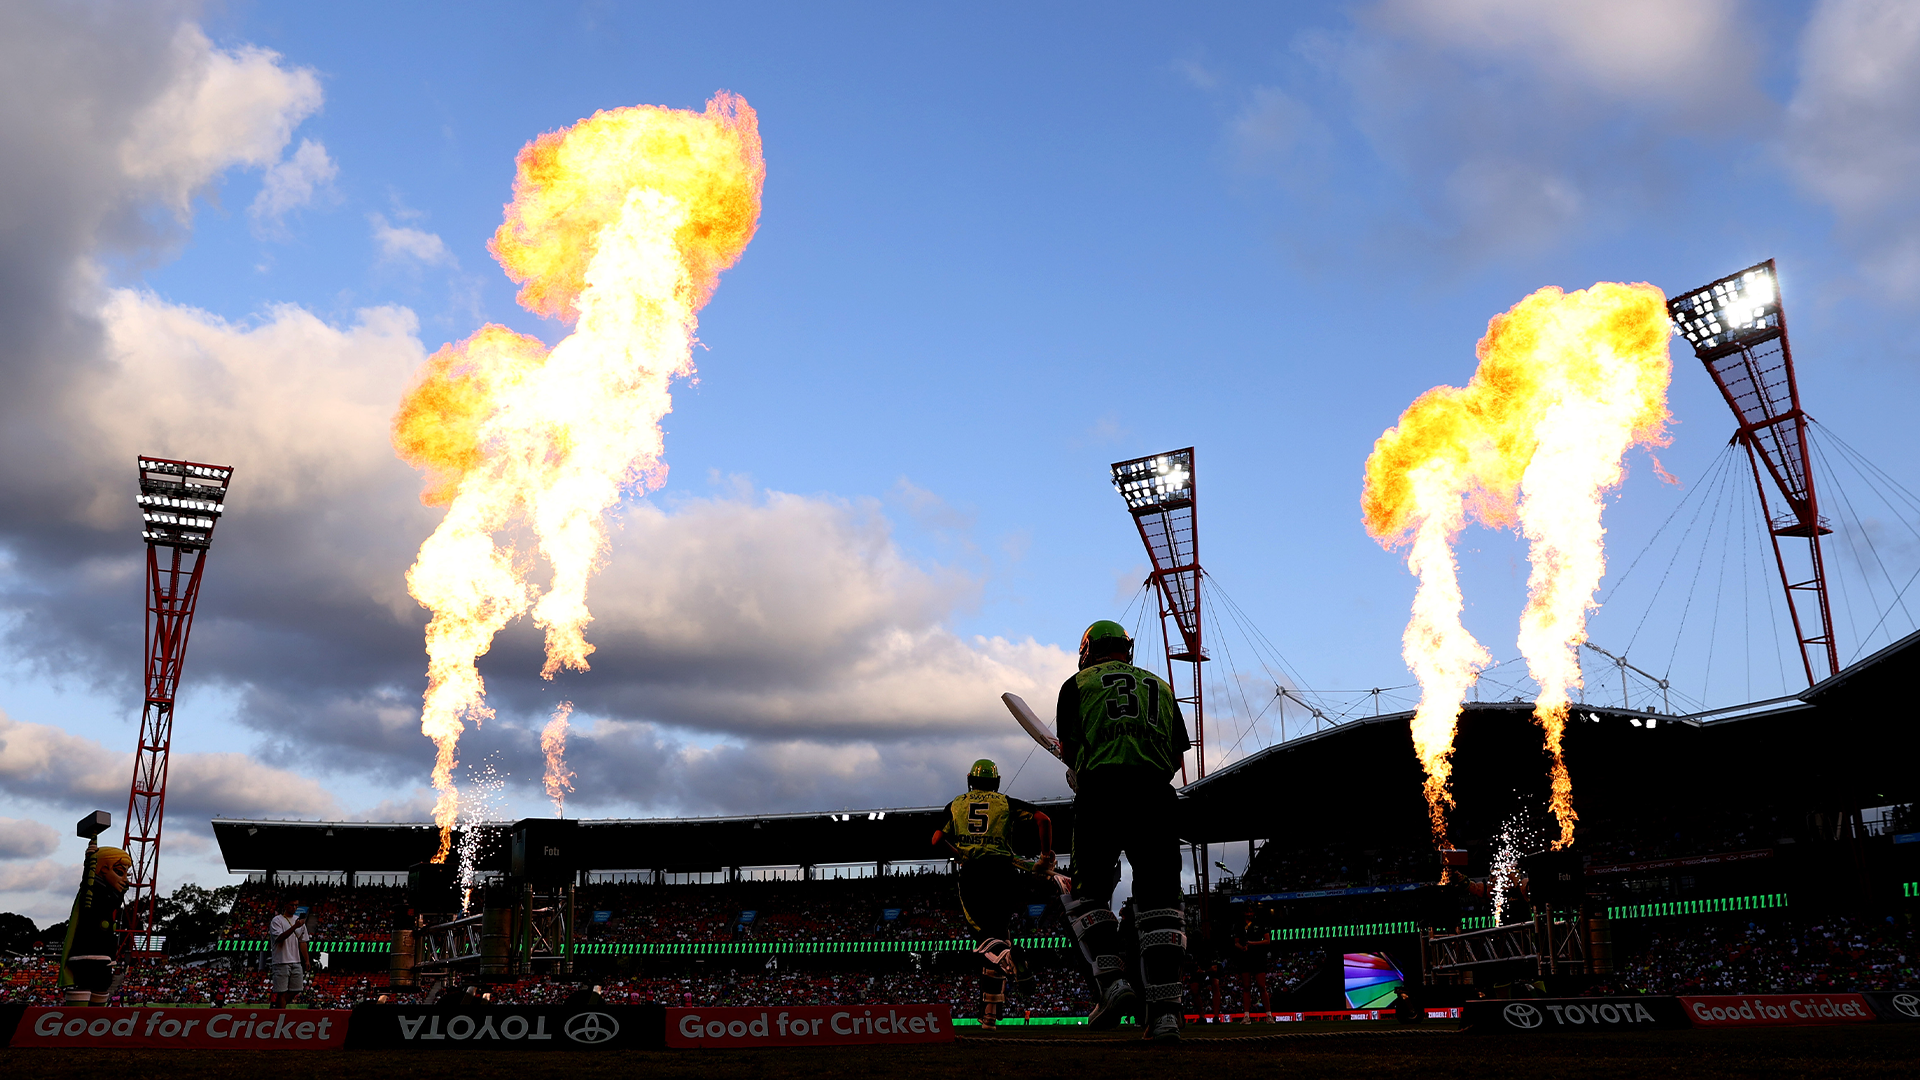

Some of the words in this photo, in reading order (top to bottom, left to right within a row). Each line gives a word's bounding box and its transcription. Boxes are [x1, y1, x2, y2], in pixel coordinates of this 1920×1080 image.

[1101, 673, 1159, 727] 31
[967, 803, 990, 835] 5
[1649, 861, 1676, 870] CHERY
[1740, 852, 1769, 860] CHERY
[1546, 1002, 1656, 1025] TOYOTA
[1693, 1001, 1756, 1022] Good
[1757, 999, 1787, 1020] for
[1789, 997, 1867, 1019] Cricket
[34, 1011, 140, 1038] Good
[144, 1010, 201, 1038] for
[205, 1013, 333, 1040] Cricket
[398, 1014, 552, 1041] TOYOTA
[679, 1012, 769, 1039] Good
[776, 1011, 824, 1037] for
[830, 1009, 941, 1037] Cricket
